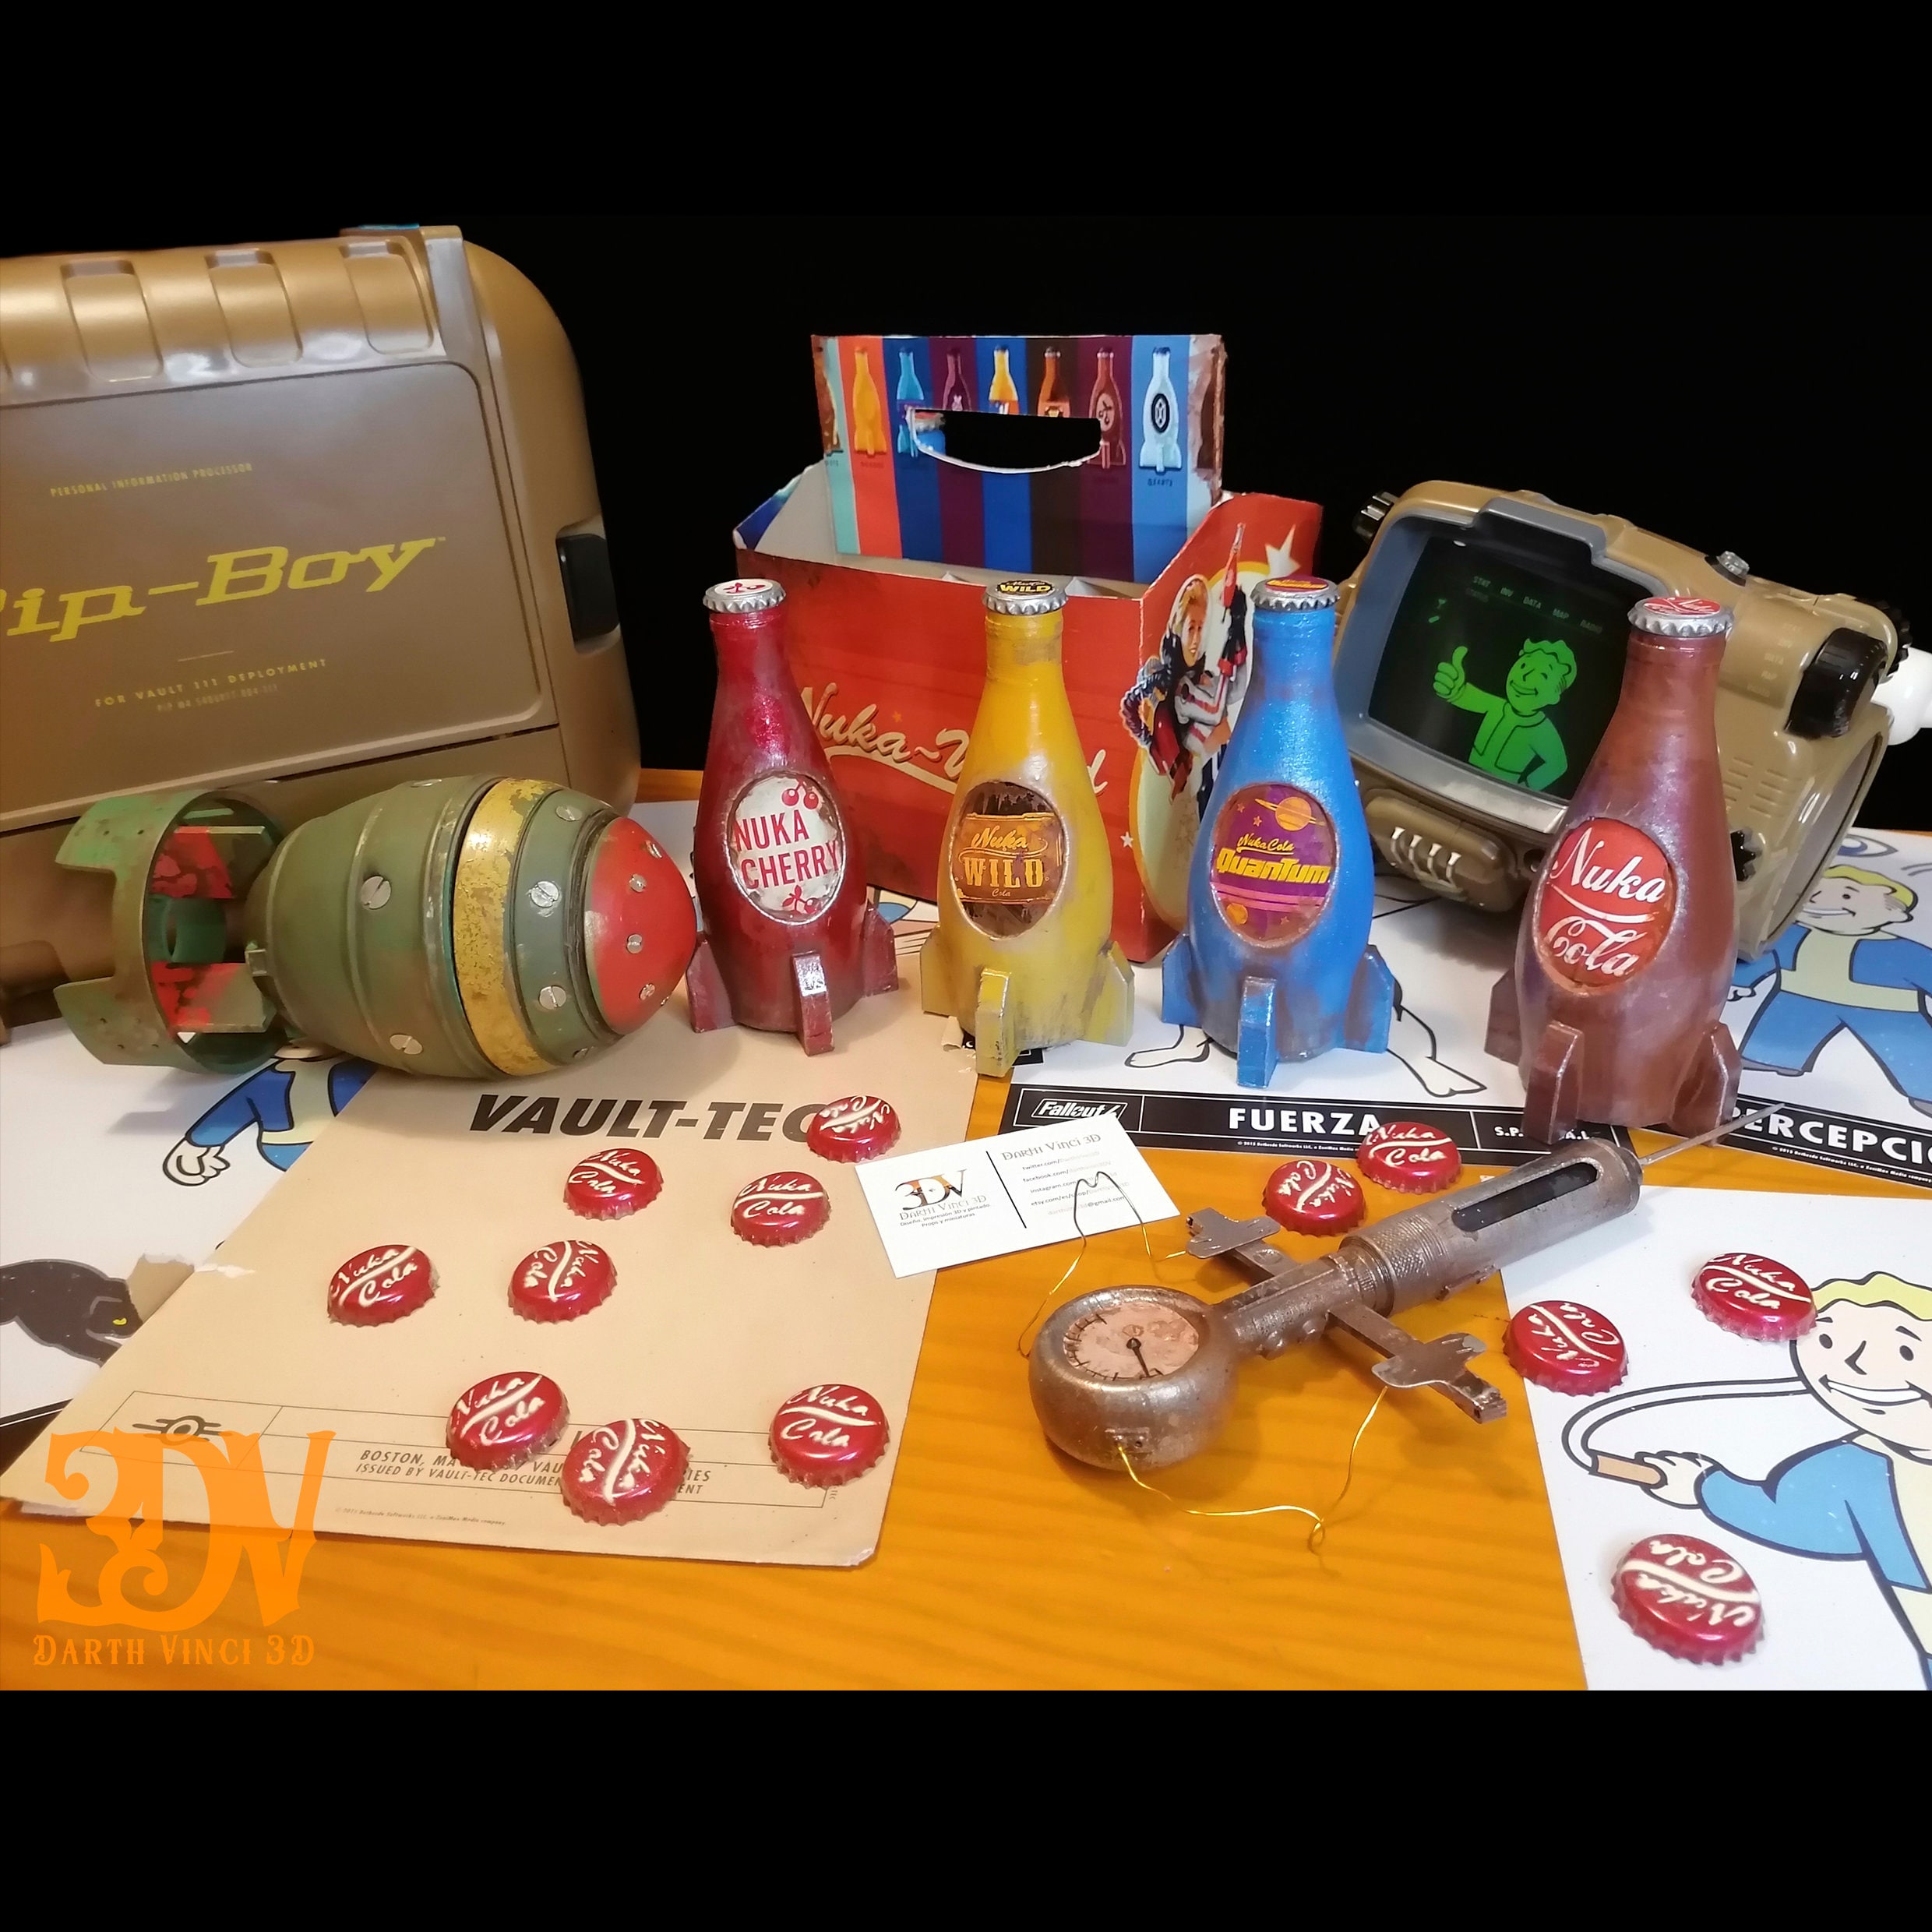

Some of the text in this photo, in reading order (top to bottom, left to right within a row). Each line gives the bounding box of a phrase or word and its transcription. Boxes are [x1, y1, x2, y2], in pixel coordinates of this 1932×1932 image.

[0, 538, 436, 643] ip-Boy
[95, 695, 125, 707] FOR
[135, 684, 183, 700] VAULT
[227, 658, 326, 683] DEPLOYMENT
[733, 809, 809, 851] NUKA
[971, 826, 1028, 848] Nuka
[741, 840, 839, 890] CHERRY
[963, 857, 1044, 888] WILD
[1549, 827, 1666, 903] Nuka
[992, 888, 1010, 897] Cola
[1543, 915, 1648, 976] Cola
[1038, 1101, 1106, 1117] Fallout
[1229, 1107, 1380, 1136] FUERZA
[1083, 1133, 1102, 1144] 3D
[1733, 1105, 1932, 1167] ERCEPCI
[590, 1149, 643, 1177] Nuka
[1385, 1148, 1447, 1168] Cola
[742, 1199, 805, 1220] Cola
[971, 1194, 987, 1204] 3D
[1706, 1276, 1781, 1310] Cola
[785, 1385, 869, 1416] Nuka
[479, 1397, 546, 1446] Cola
[781, 1418, 851, 1448] Cola
[355, 1463, 401, 1475] ISSUED
[405, 1465, 425, 1477] BY
[428, 1468, 495, 1482] VAULT-TEC
[499, 1473, 563, 1487] DOCUMEN
[360, 1449, 425, 1466] BOSTON,
[682, 1469, 711, 1482] IES
